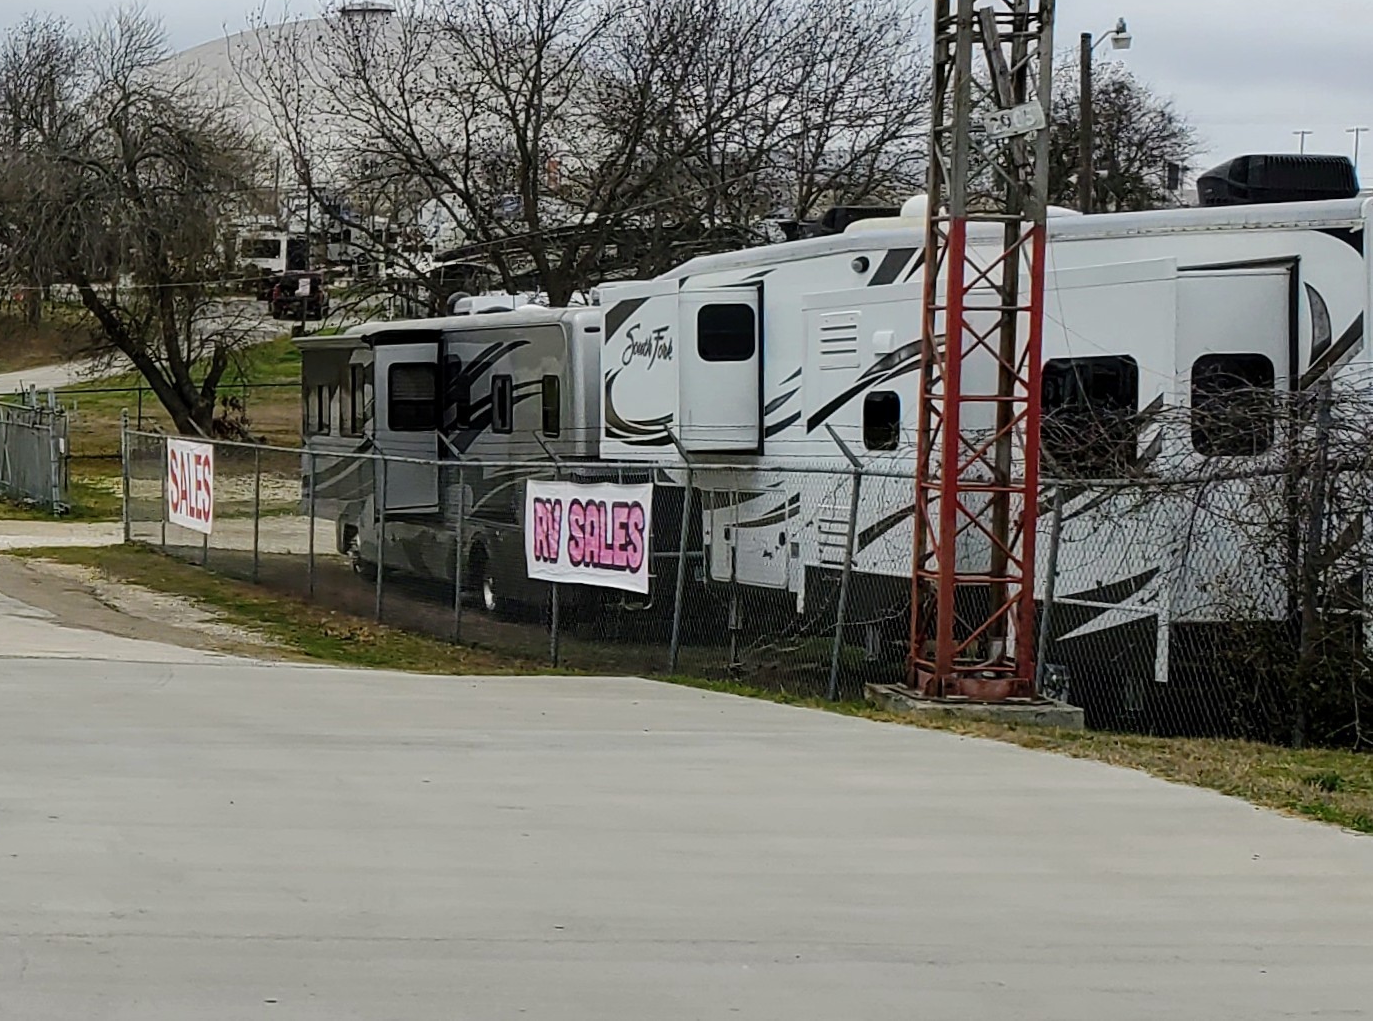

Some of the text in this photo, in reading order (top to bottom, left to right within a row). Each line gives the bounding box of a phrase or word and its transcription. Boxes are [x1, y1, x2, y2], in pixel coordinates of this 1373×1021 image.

[622, 323, 673, 370] South Fork
[168, 448, 212, 523] SALES
[533, 497, 645, 574] RV SALES
